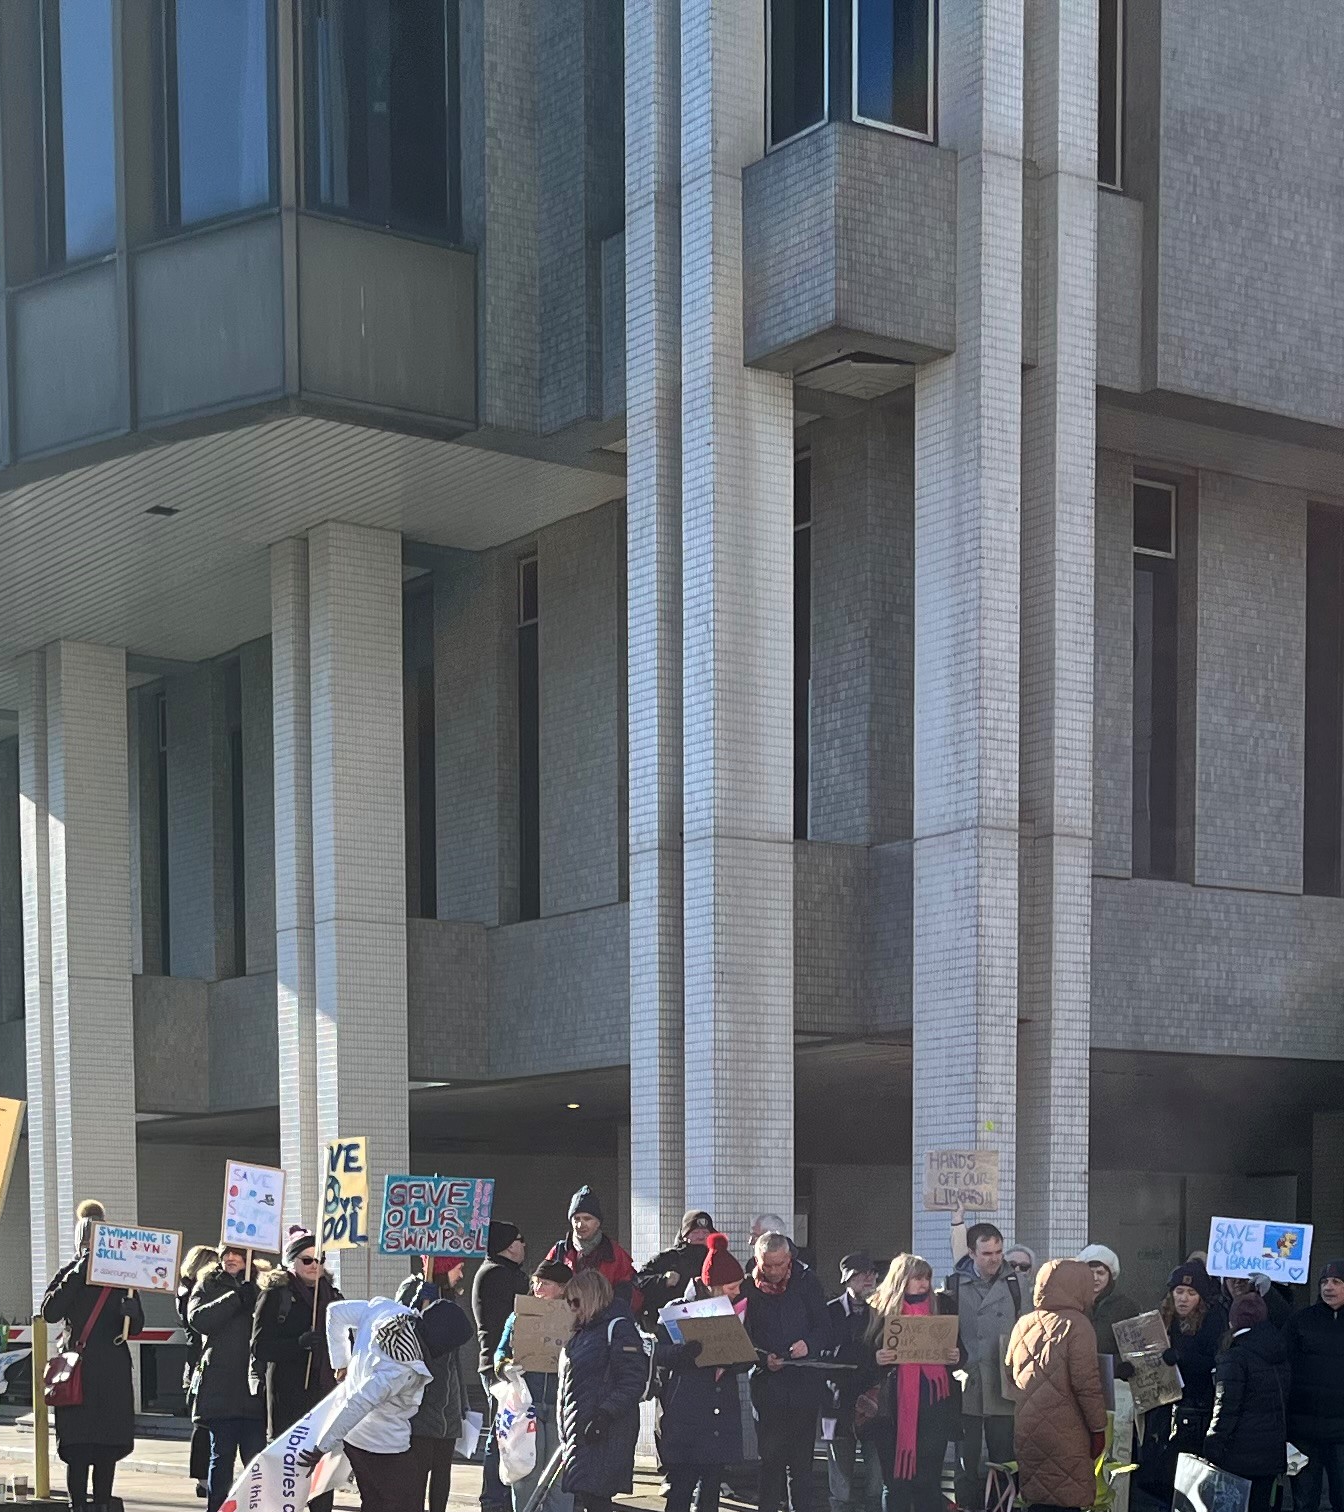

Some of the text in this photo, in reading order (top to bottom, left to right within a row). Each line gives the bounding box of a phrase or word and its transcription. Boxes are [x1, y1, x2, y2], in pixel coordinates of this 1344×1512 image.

[929, 1151, 977, 1171] HANDS
[938, 1171, 991, 1187] OFF OUR
[388, 1181, 471, 1207] SAVE
[386, 1207, 464, 1227] OUR
[98, 1226, 172, 1245] SWIMMING IS
[98, 1236, 106, 1248] A
[1215, 1222, 1260, 1242] SAVE
[95, 1247, 127, 1262] SKILL
[1212, 1238, 1244, 1256] OUR
[282, 1424, 312, 1499] libraries
[249, 1462, 264, 1511] all this
